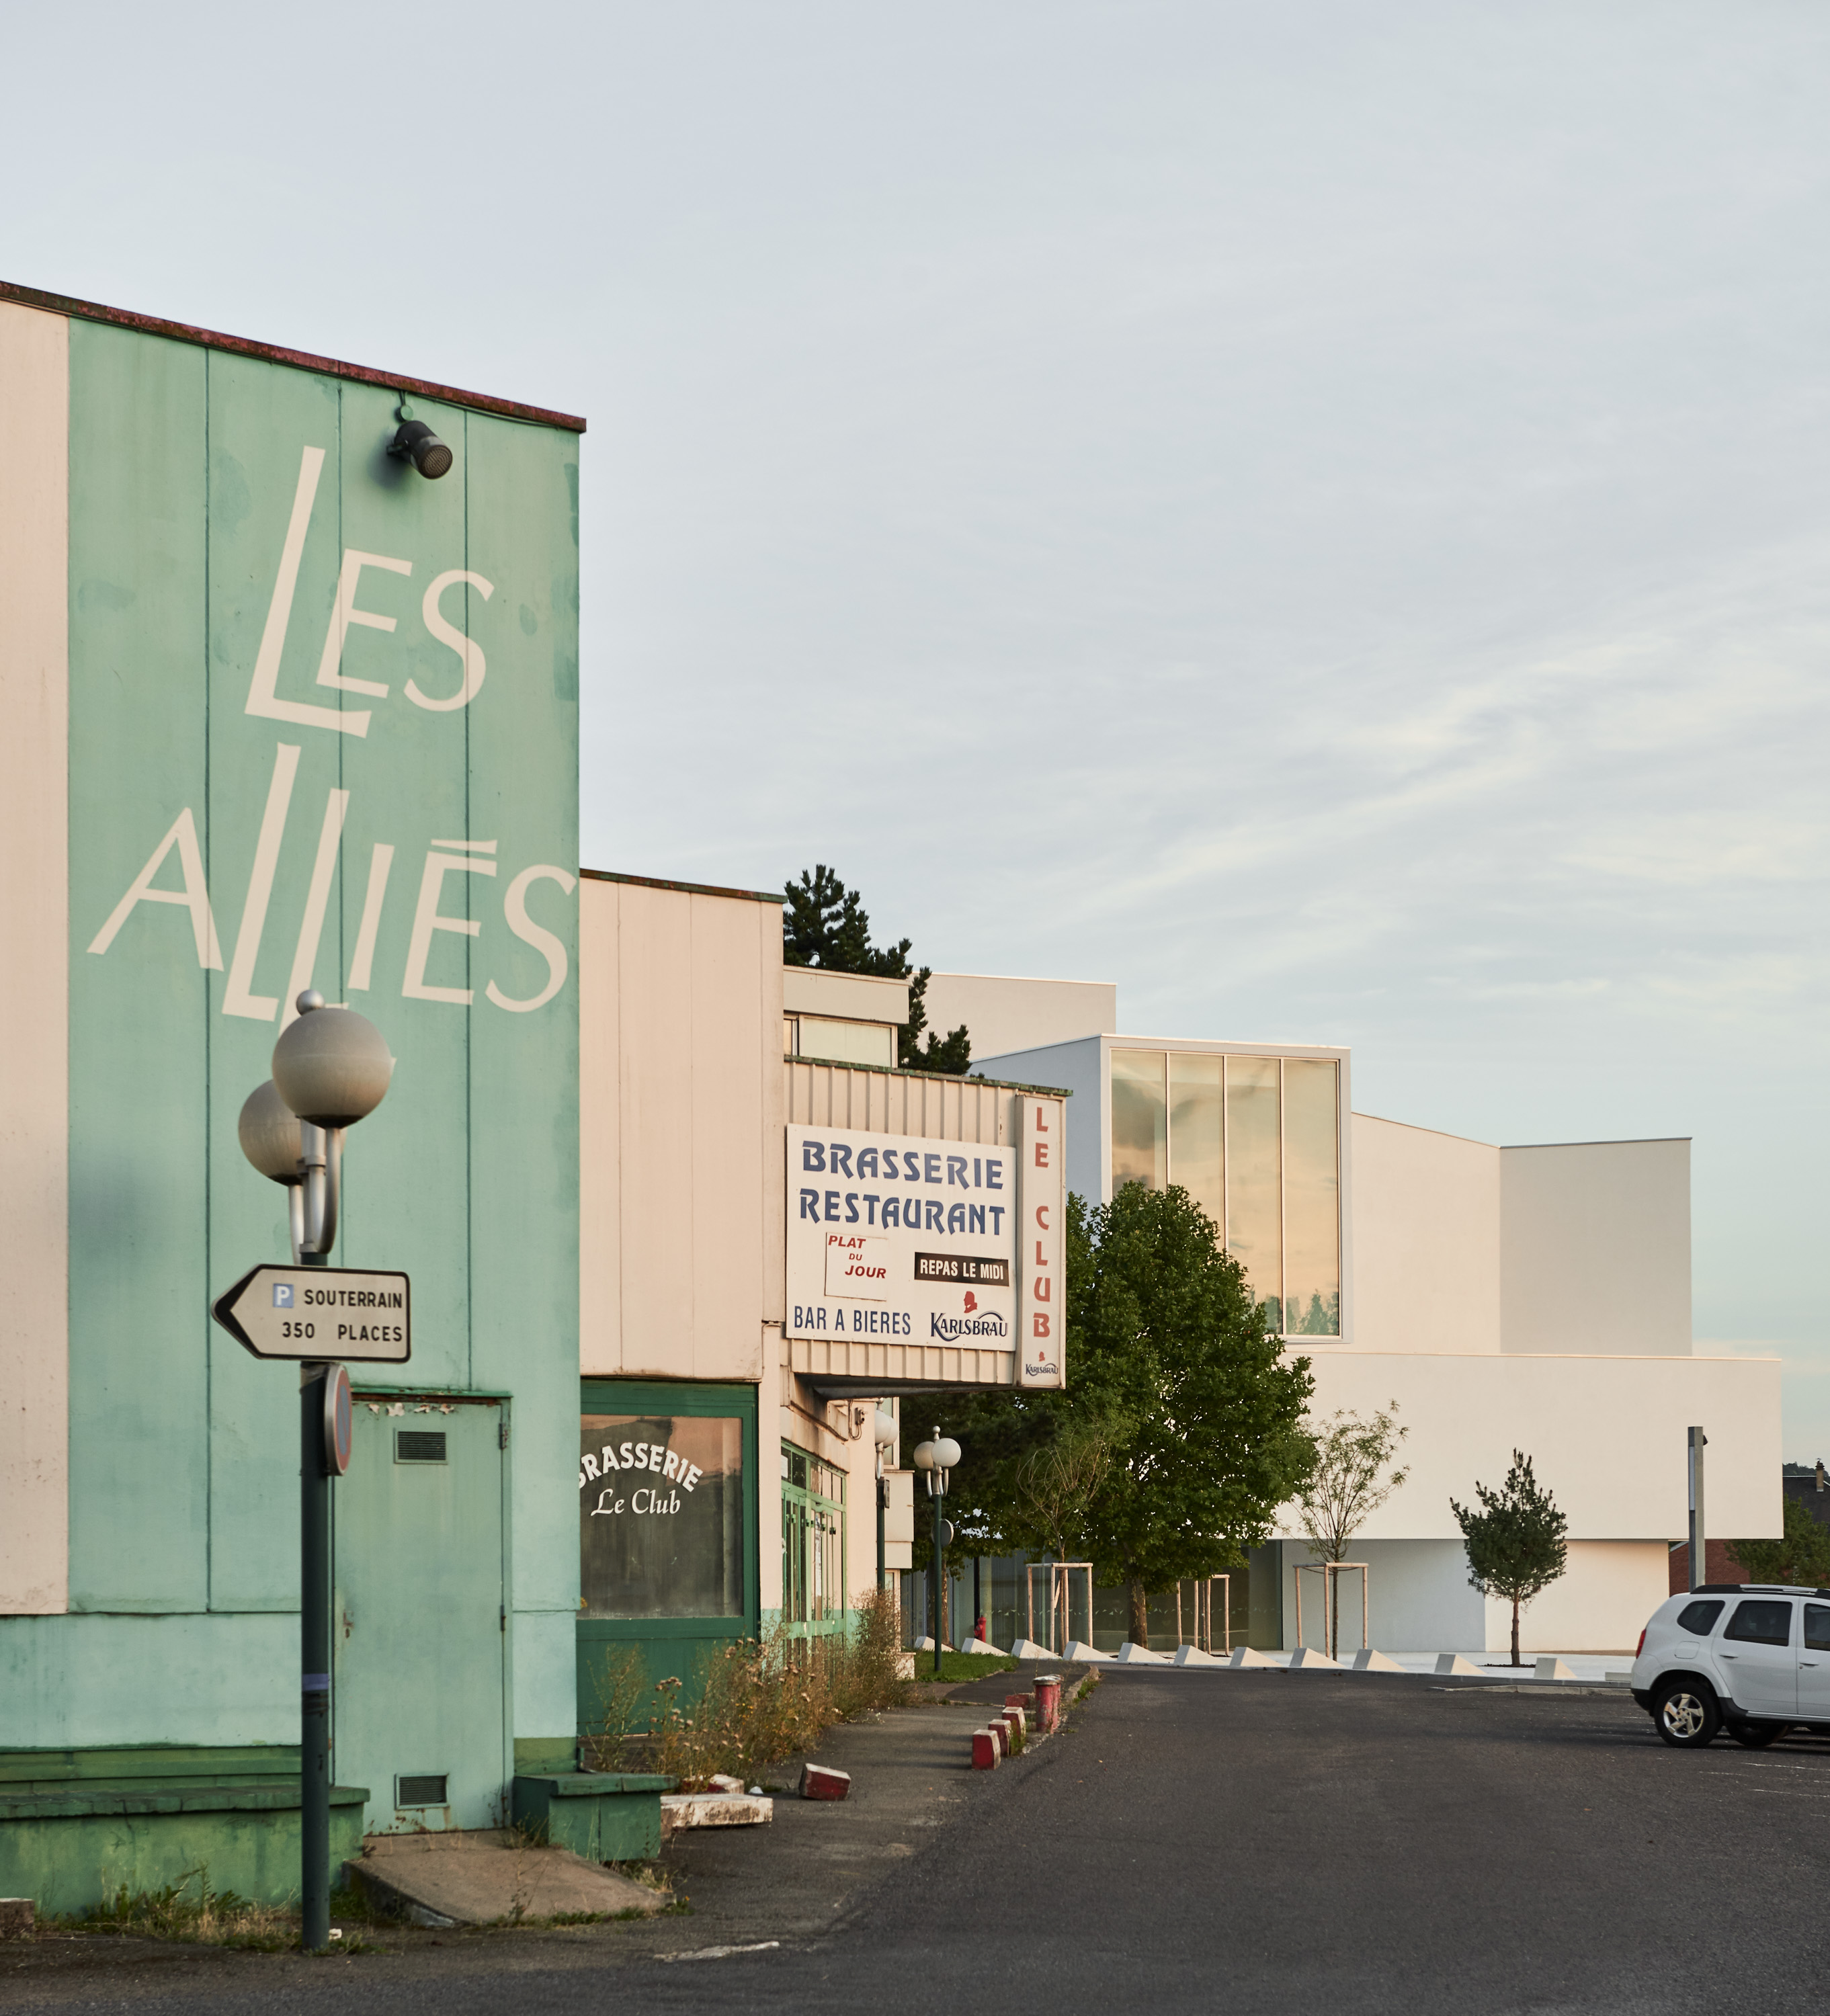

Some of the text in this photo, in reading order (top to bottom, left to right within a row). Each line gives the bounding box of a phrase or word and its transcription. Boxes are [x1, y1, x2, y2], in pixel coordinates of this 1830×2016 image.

[245, 446, 495, 738] LES
[802, 1140, 1003, 1189] BRASSERIE
[800, 1188, 1005, 1235] RESTAURANT
[828, 1236, 866, 1249] PLAT
[849, 1253, 862, 1261] DU
[845, 1265, 886, 1278] JOUR
[920, 1259, 1003, 1279] REPAS LE MIDI
[276, 1286, 402, 1308] P SOUTERRAIN
[282, 1322, 402, 1341] 350 PLACES
[794, 1306, 911, 1335] BAR A BIERES
[590, 1488, 681, 1516] Le Club
